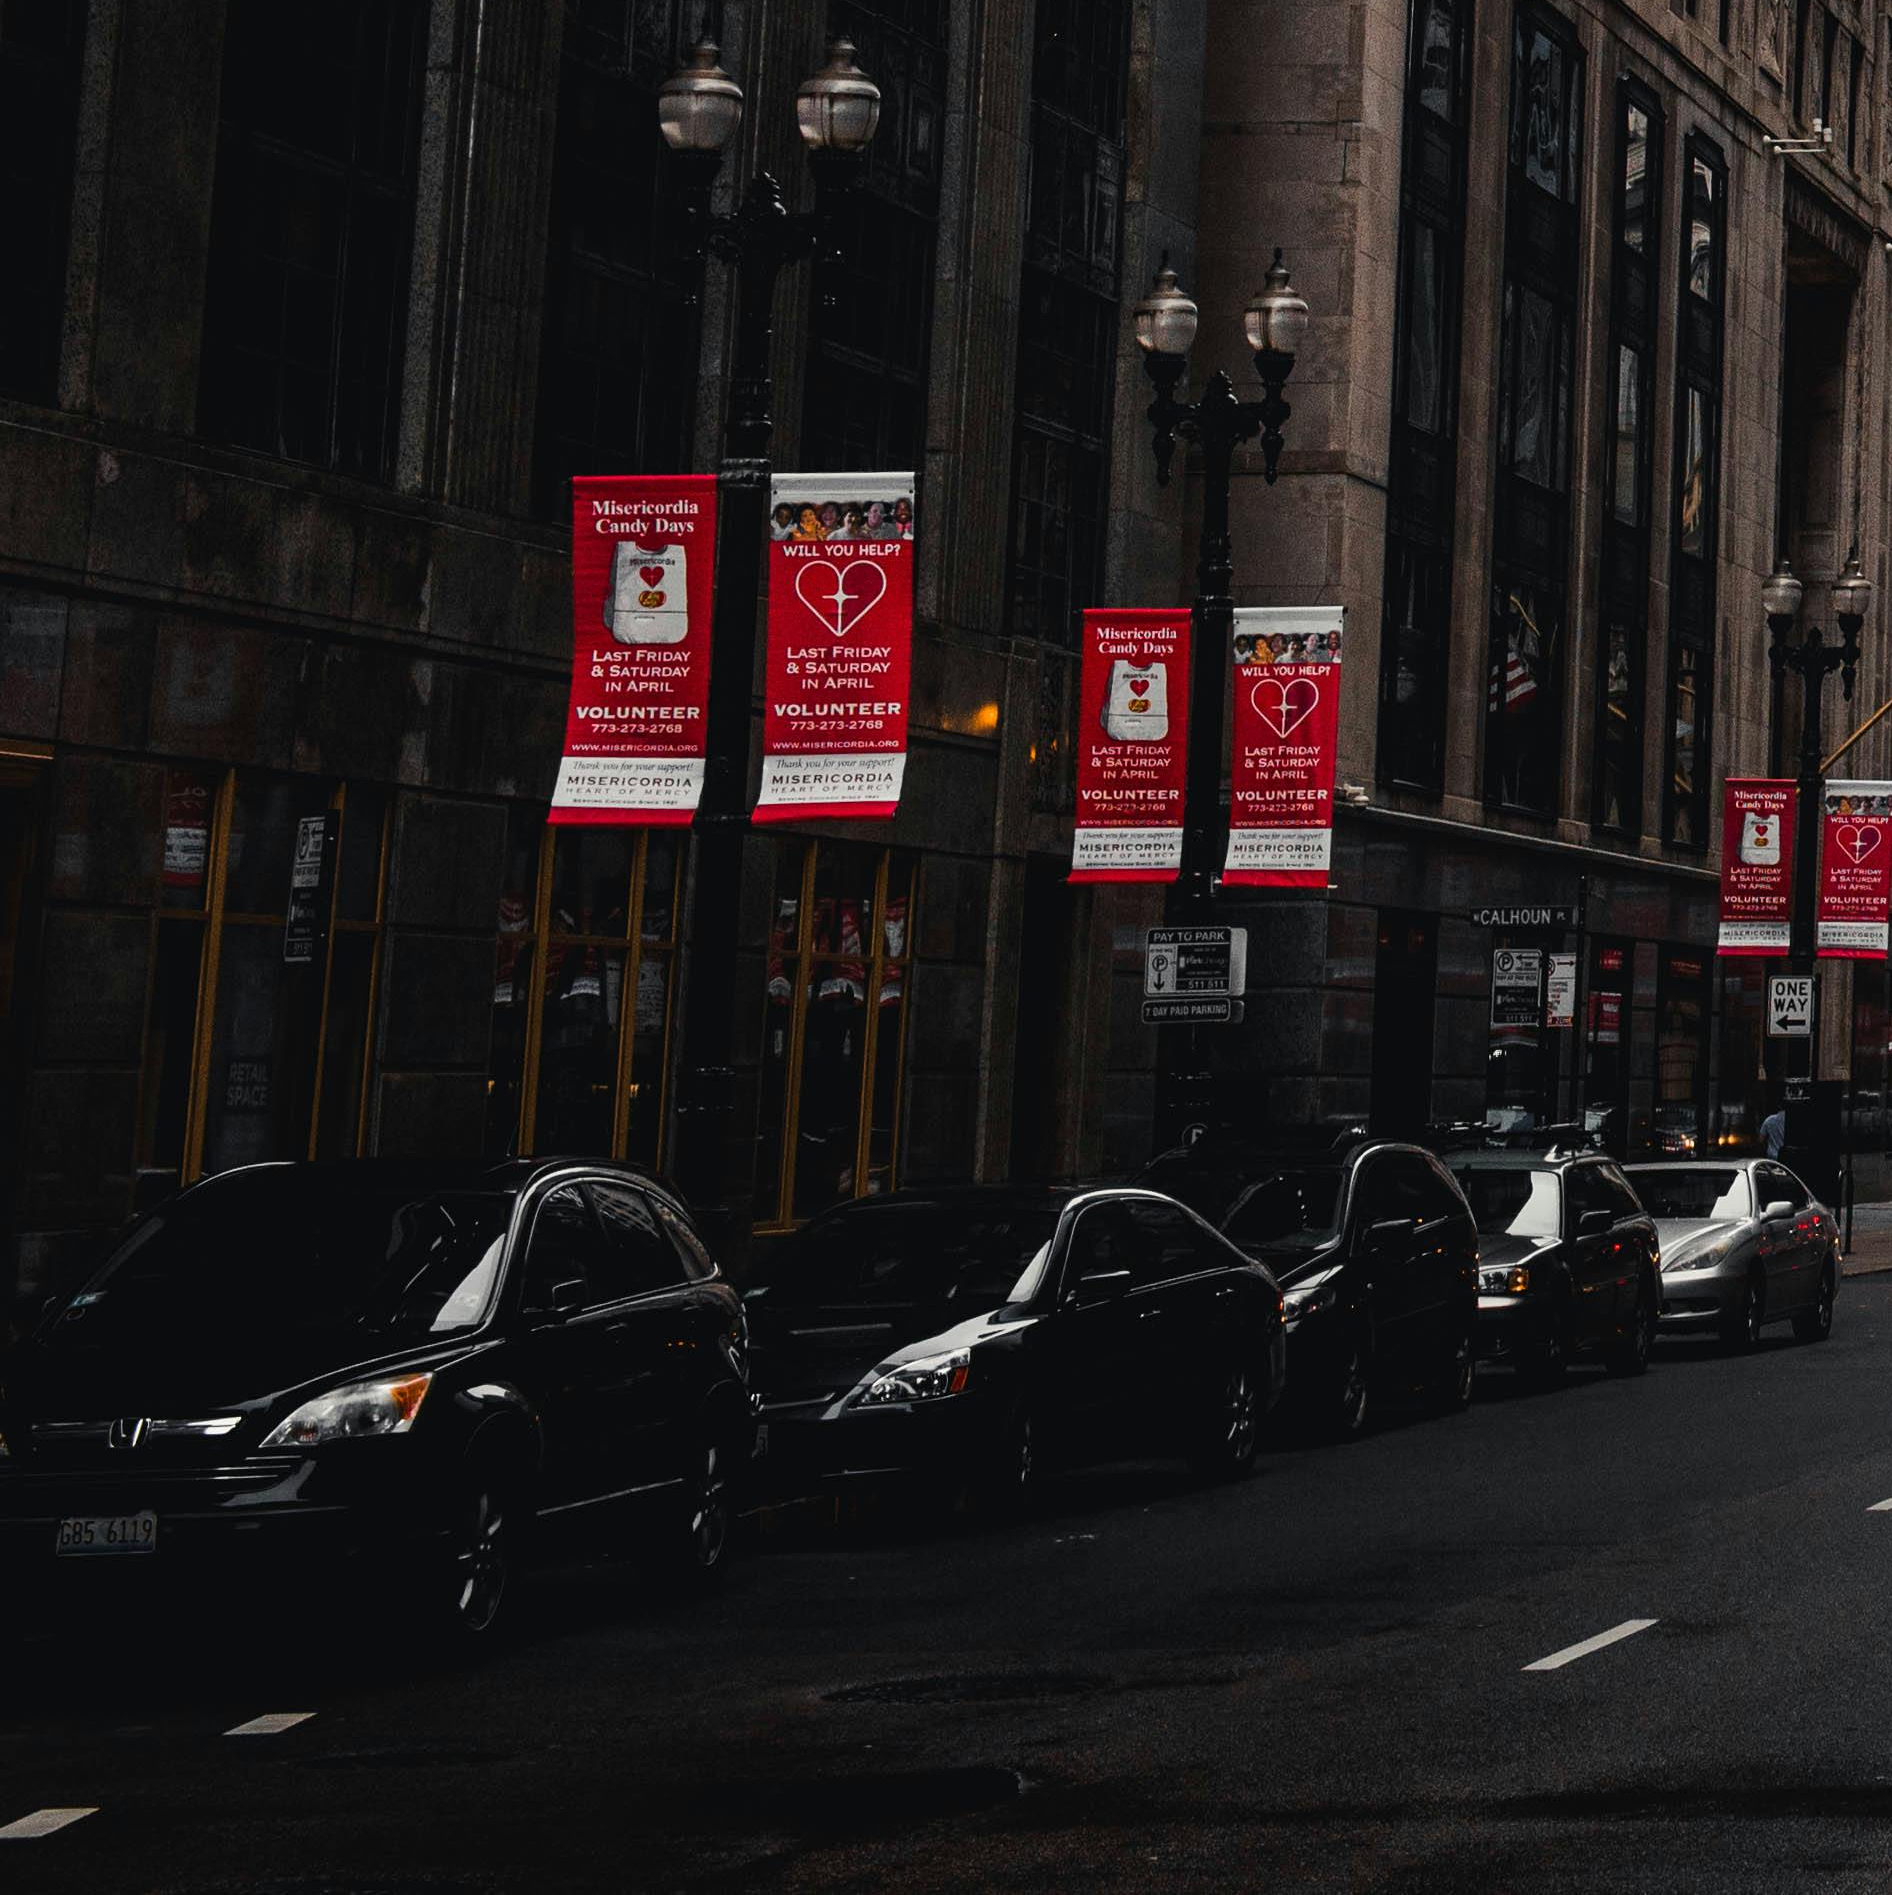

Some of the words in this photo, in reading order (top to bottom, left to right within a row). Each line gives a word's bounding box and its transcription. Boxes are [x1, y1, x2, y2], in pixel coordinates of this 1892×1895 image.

[592, 501, 698, 515] Misericordia
[596, 518, 648, 535] Candy
[656, 519, 694, 534] Days
[783, 545, 820, 556] WILL
[825, 544, 854, 556] YOU
[859, 543, 901, 556] HELP?
[1096, 628, 1177, 641] Misericordia
[1099, 642, 1139, 655] Candy
[1144, 643, 1174, 655] Days
[576, 707, 699, 719] VOLUNTEER
[774, 702, 900, 716] VOLUNTEER
[568, 776, 692, 786] MISERICORDIA
[772, 773, 893, 784] MISERICORDIA
[1082, 790, 1179, 799] VOLUNTEER
[1236, 790, 1328, 801] VOLUNTEER
[1234, 844, 1323, 852] MISERICORDIA
[1724, 896, 1786, 904] VOLUNTEER
[1824, 897, 1887, 905] VOLUNTEER
[1481, 909, 1551, 925] CALHOUN
[1154, 933, 1173, 941] PAY
[1178, 932, 1192, 941] TO
[1196, 931, 1224, 940] PARK
[1776, 983, 1808, 996] ONE
[1153, 1007, 1168, 1016] DAY
[1170, 1006, 1188, 1015] PAID
[1192, 1005, 1226, 1014] PARKING
[1774, 999, 1808, 1012] WAY
[61, 1521, 94, 1544] G85
[107, 1520, 152, 1543] 6119
